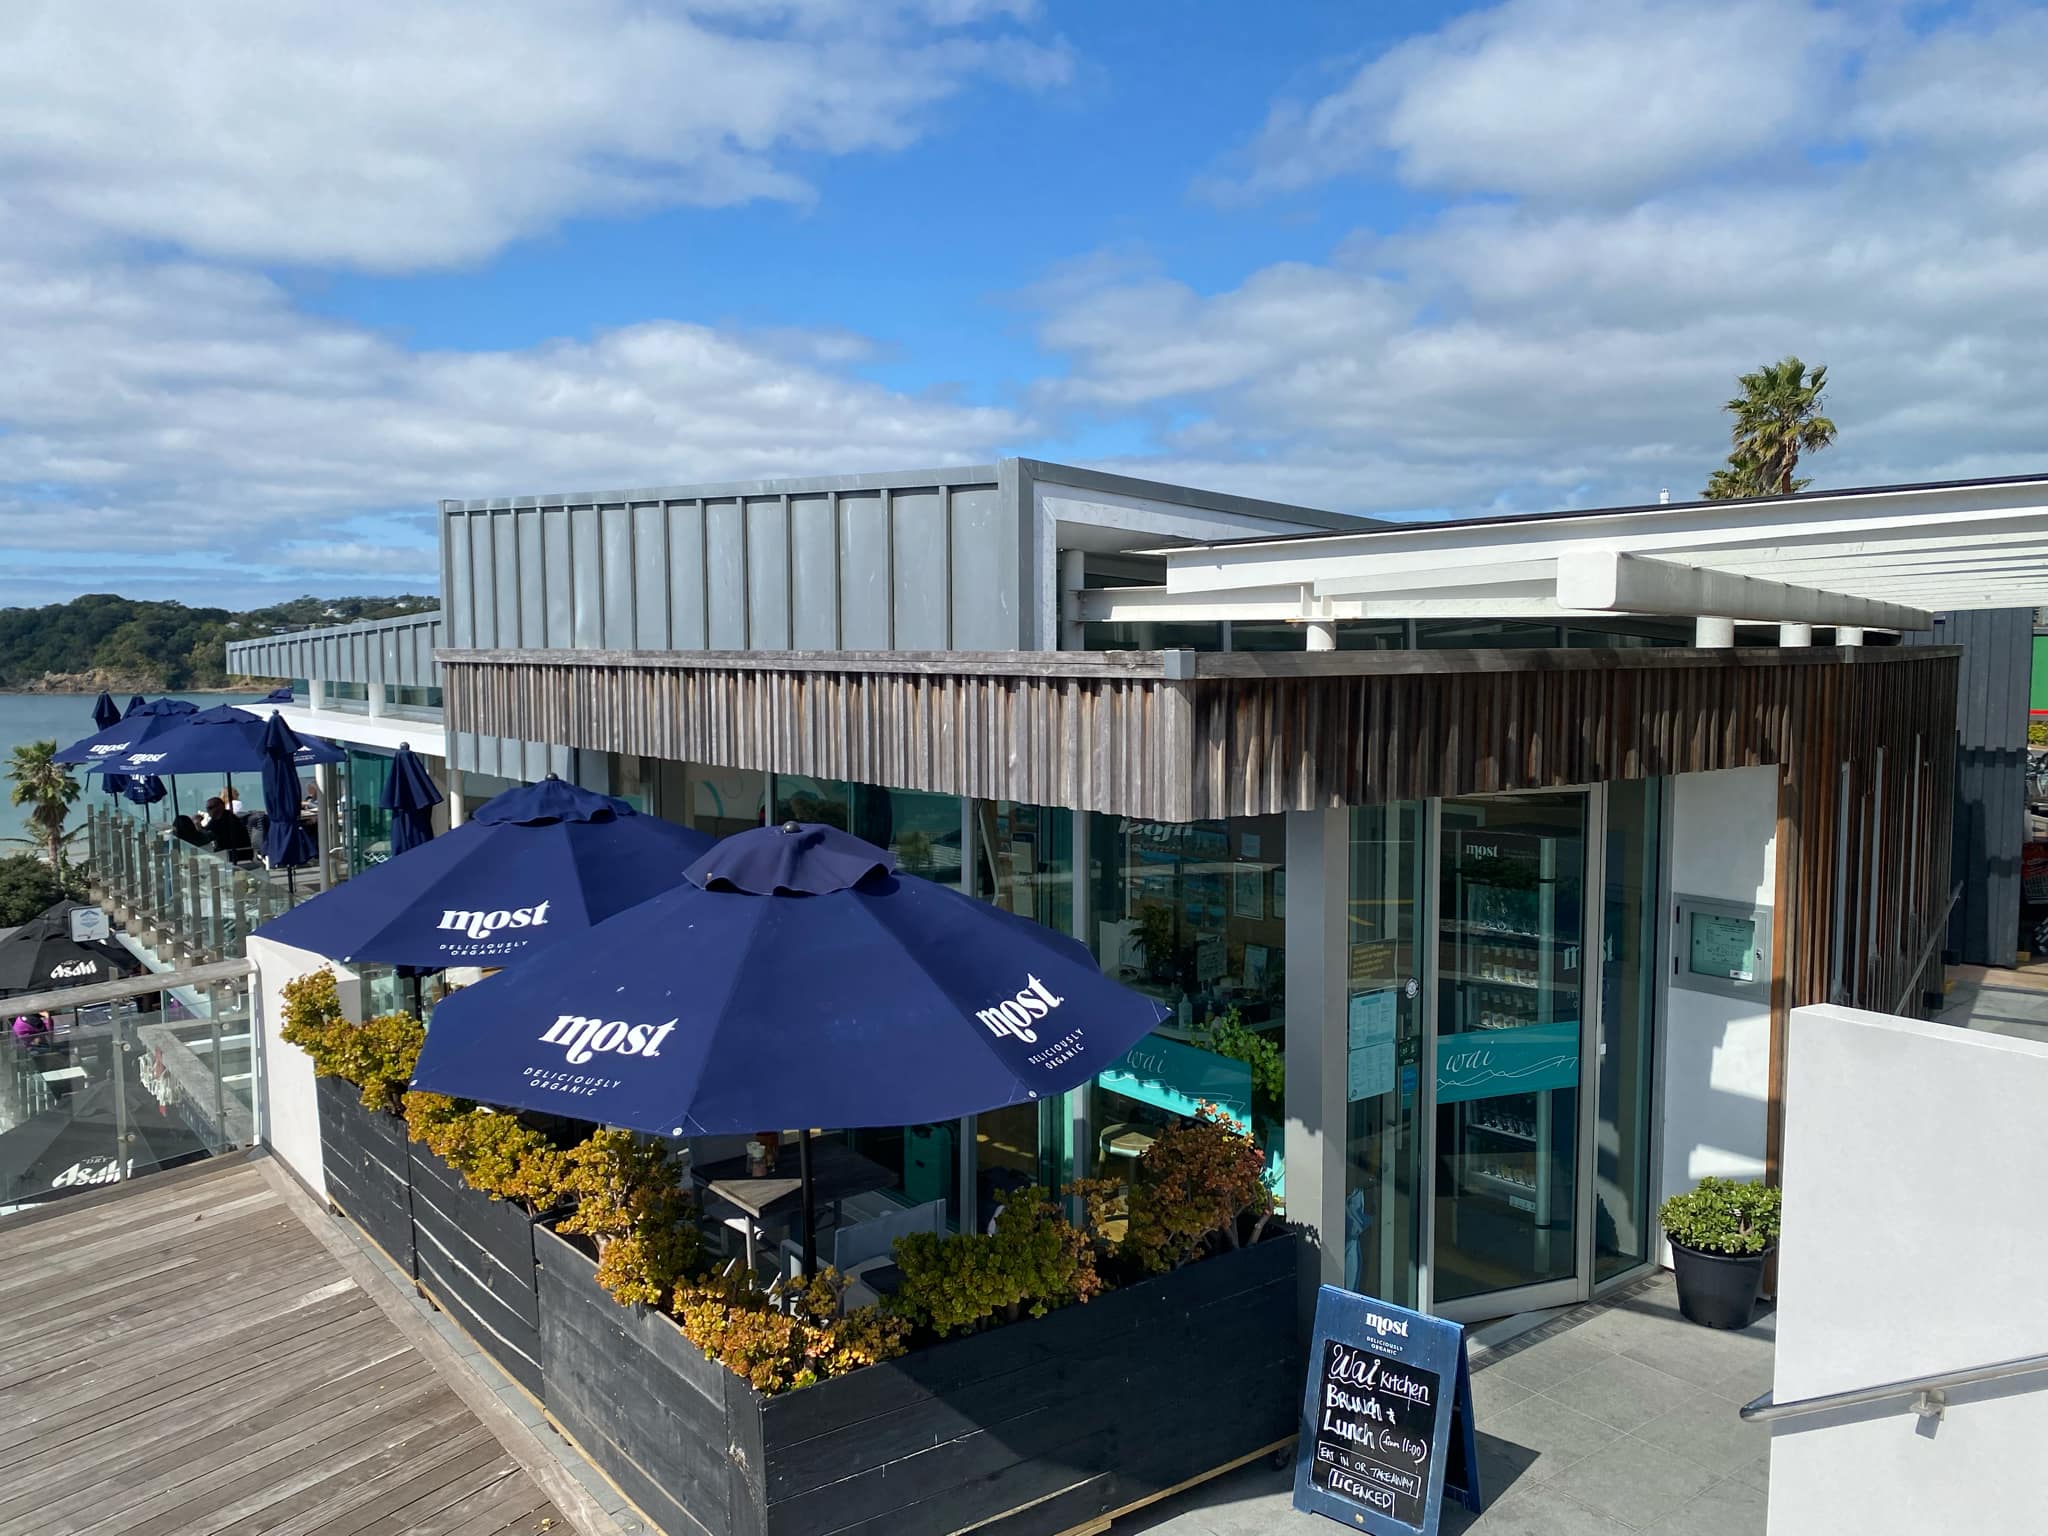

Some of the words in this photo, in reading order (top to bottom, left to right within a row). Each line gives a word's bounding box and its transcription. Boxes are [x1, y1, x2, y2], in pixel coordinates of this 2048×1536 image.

[1466, 844, 1499, 860] most
[436, 900, 551, 939] most
[439, 940, 528, 950] DELICIOUSLY
[450, 948, 511, 956] ORGANIC
[50, 960, 97, 979] Asahi
[975, 973, 1064, 1043] most
[538, 1015, 679, 1064] most
[1027, 1028, 1084, 1064] DELICIOUSLY
[1045, 1043, 1085, 1069] ORGANIC
[1127, 1049, 1167, 1074] wai
[1446, 1040, 1495, 1073] wai
[523, 1067, 622, 1088] DELICIOUSLY
[529, 1079, 597, 1096] ORGANIC
[51, 1158, 134, 1188] Asahi
[1365, 1313, 1409, 1338] most
[1366, 1336, 1403, 1352] DELICIOUSLY
[1371, 1343, 1398, 1356] ORGANIC
[1331, 1344, 1381, 1385] Wai
[1323, 1409, 1375, 1449] Lunch
[1320, 1447, 1334, 1462] EAT
[1354, 1462, 1369, 1476] OR
[1370, 1468, 1414, 1495] TAKEAWAY
